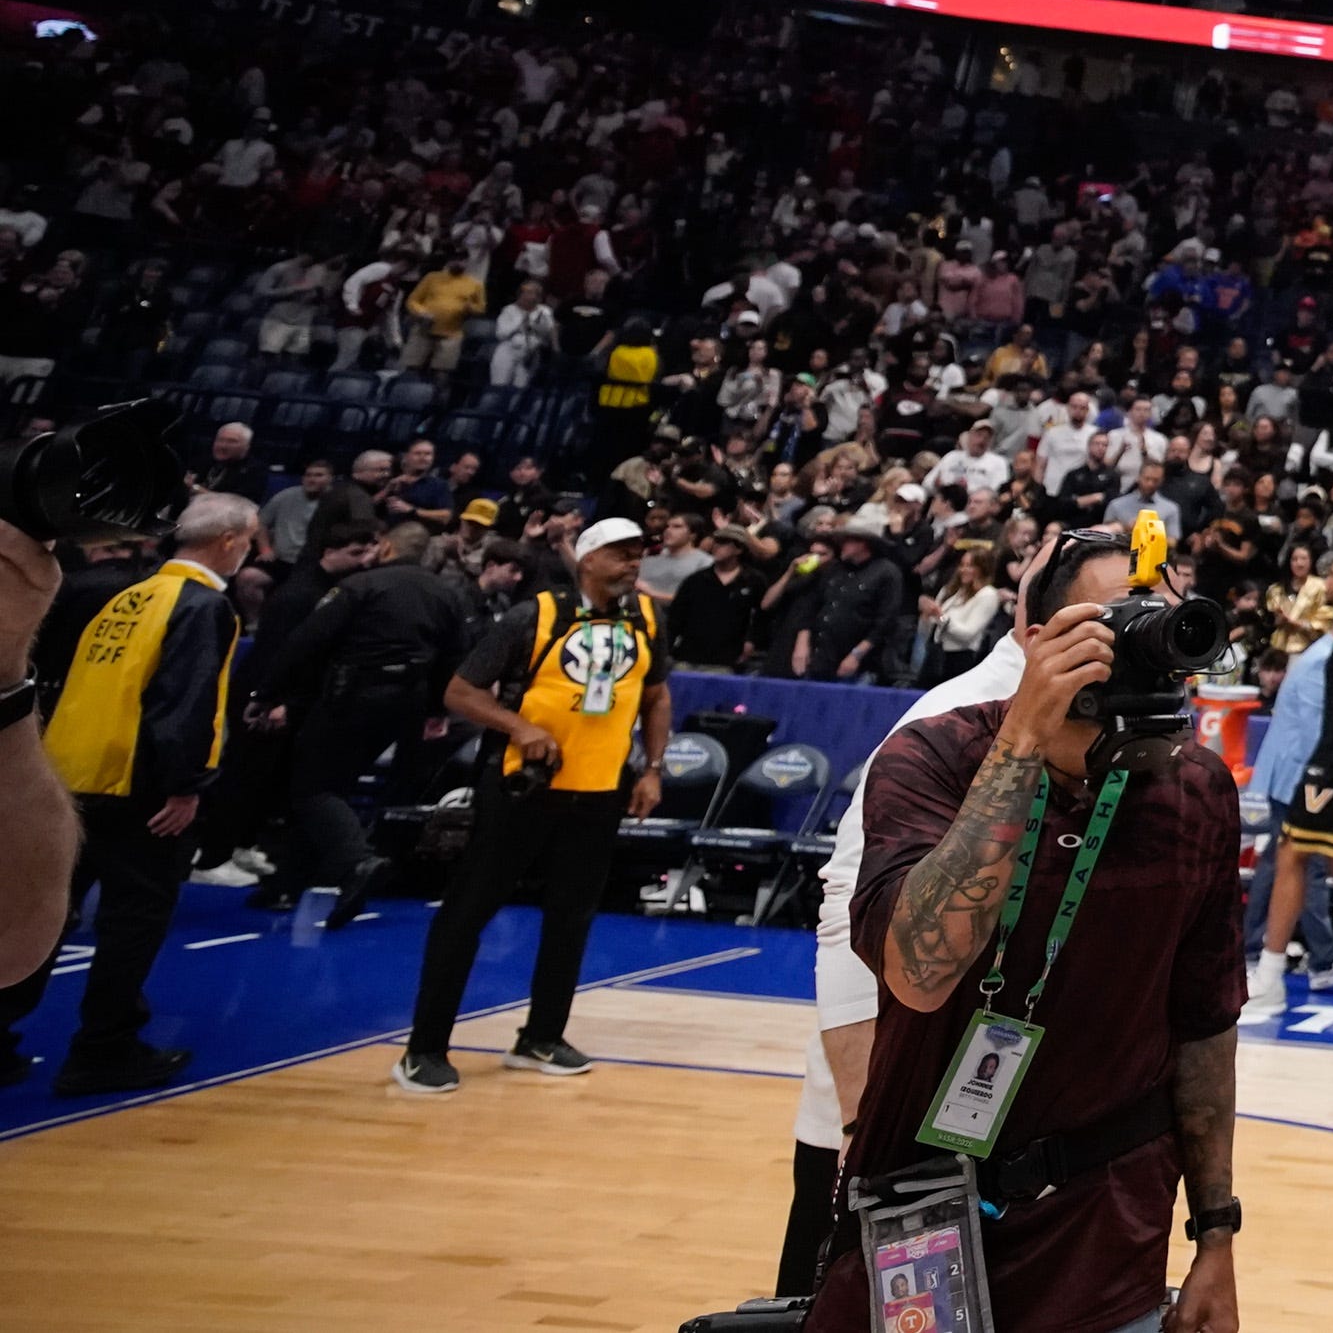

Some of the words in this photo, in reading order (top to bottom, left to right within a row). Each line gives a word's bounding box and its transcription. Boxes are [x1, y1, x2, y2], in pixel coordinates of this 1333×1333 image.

[960, 1085, 993, 1100] IZQUIERDO
[950, 1264, 960, 1276] 2
[955, 1309, 964, 1321] 5
